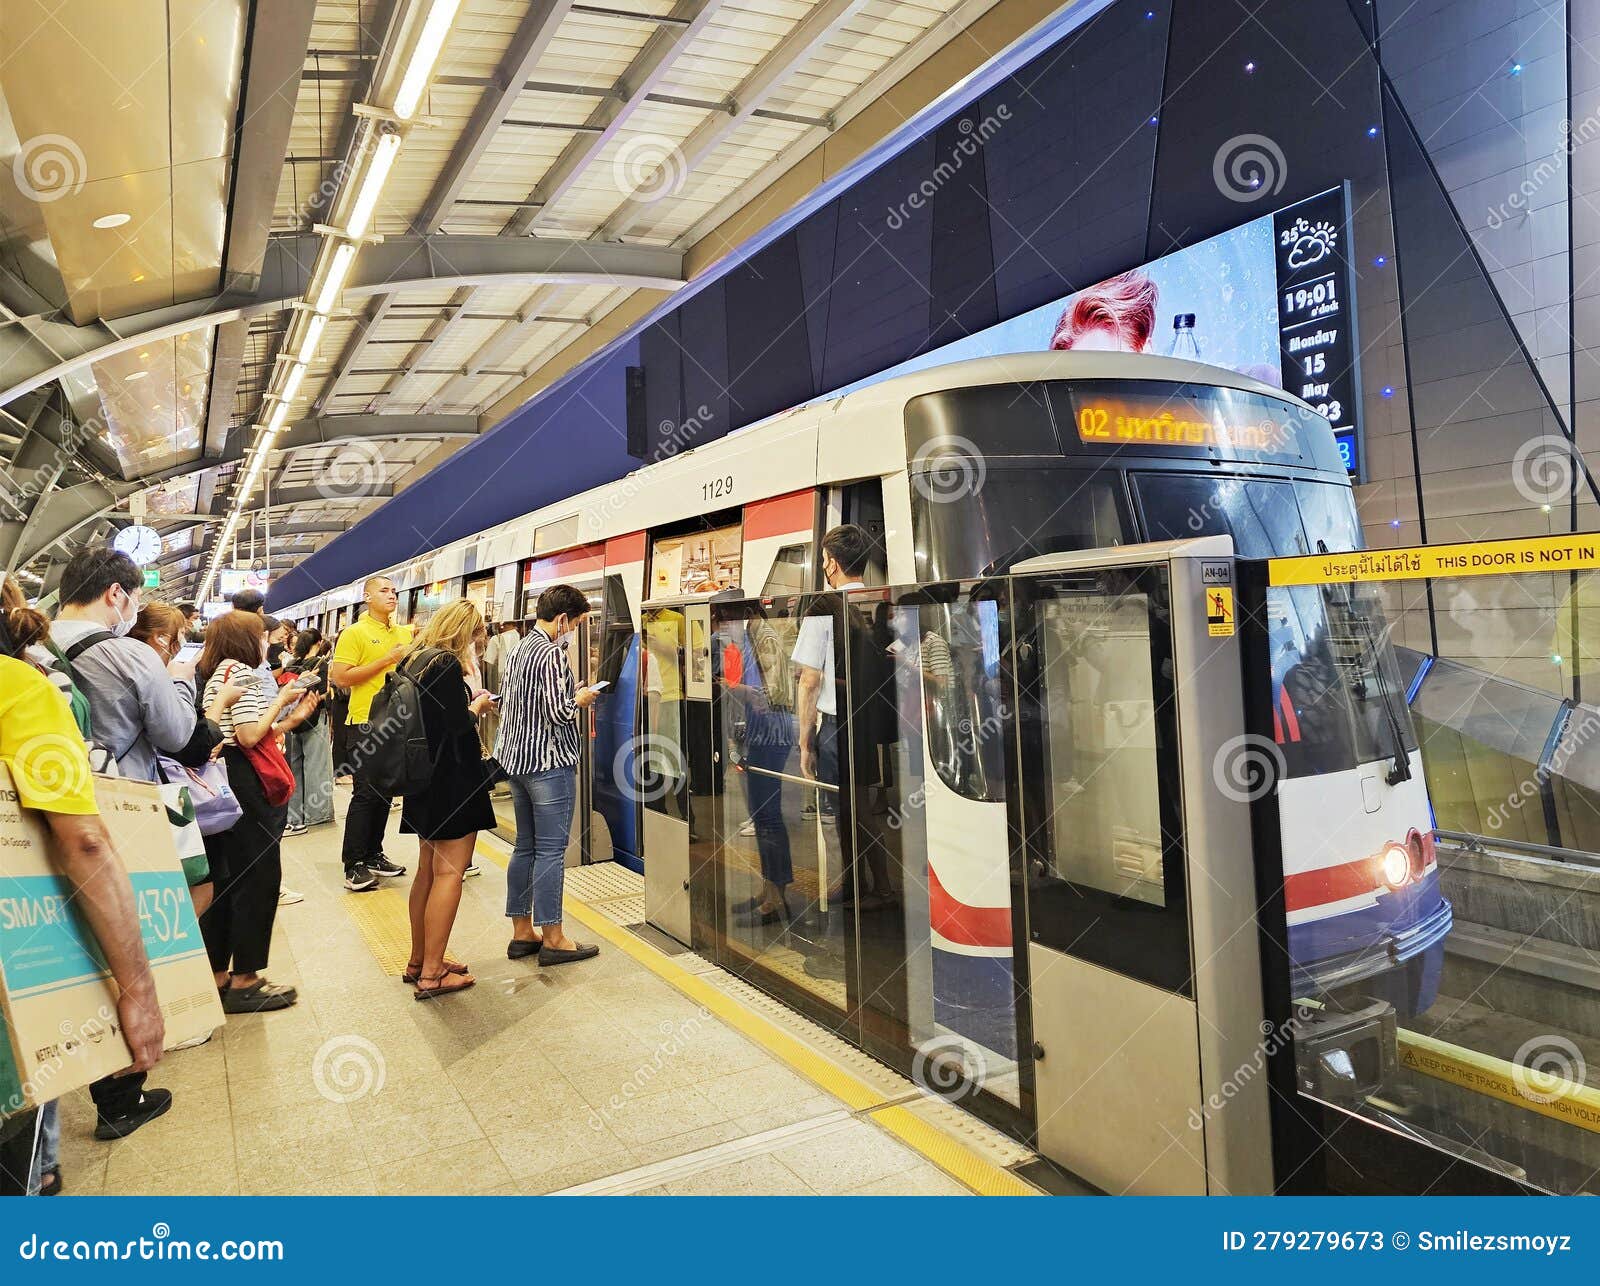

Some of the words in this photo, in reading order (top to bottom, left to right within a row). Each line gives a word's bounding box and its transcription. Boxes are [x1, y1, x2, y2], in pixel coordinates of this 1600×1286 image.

[1286, 280, 1336, 314] 19:01
[1289, 328, 1337, 353] Monday
[1304, 353, 1326, 377] 15
[1302, 382, 1330, 399] May
[1080, 408, 1110, 437] 02
[702, 475, 734, 501] 1129
[1436, 556, 1467, 568] THIS
[1472, 552, 1515, 566] DOOR
[1521, 551, 1534, 563] IS
[1540, 548, 1573, 562] NOT
[1579, 547, 1595, 560] IN
[1205, 567, 1228, 578] AN-04
[0, 896, 68, 929] SMART
